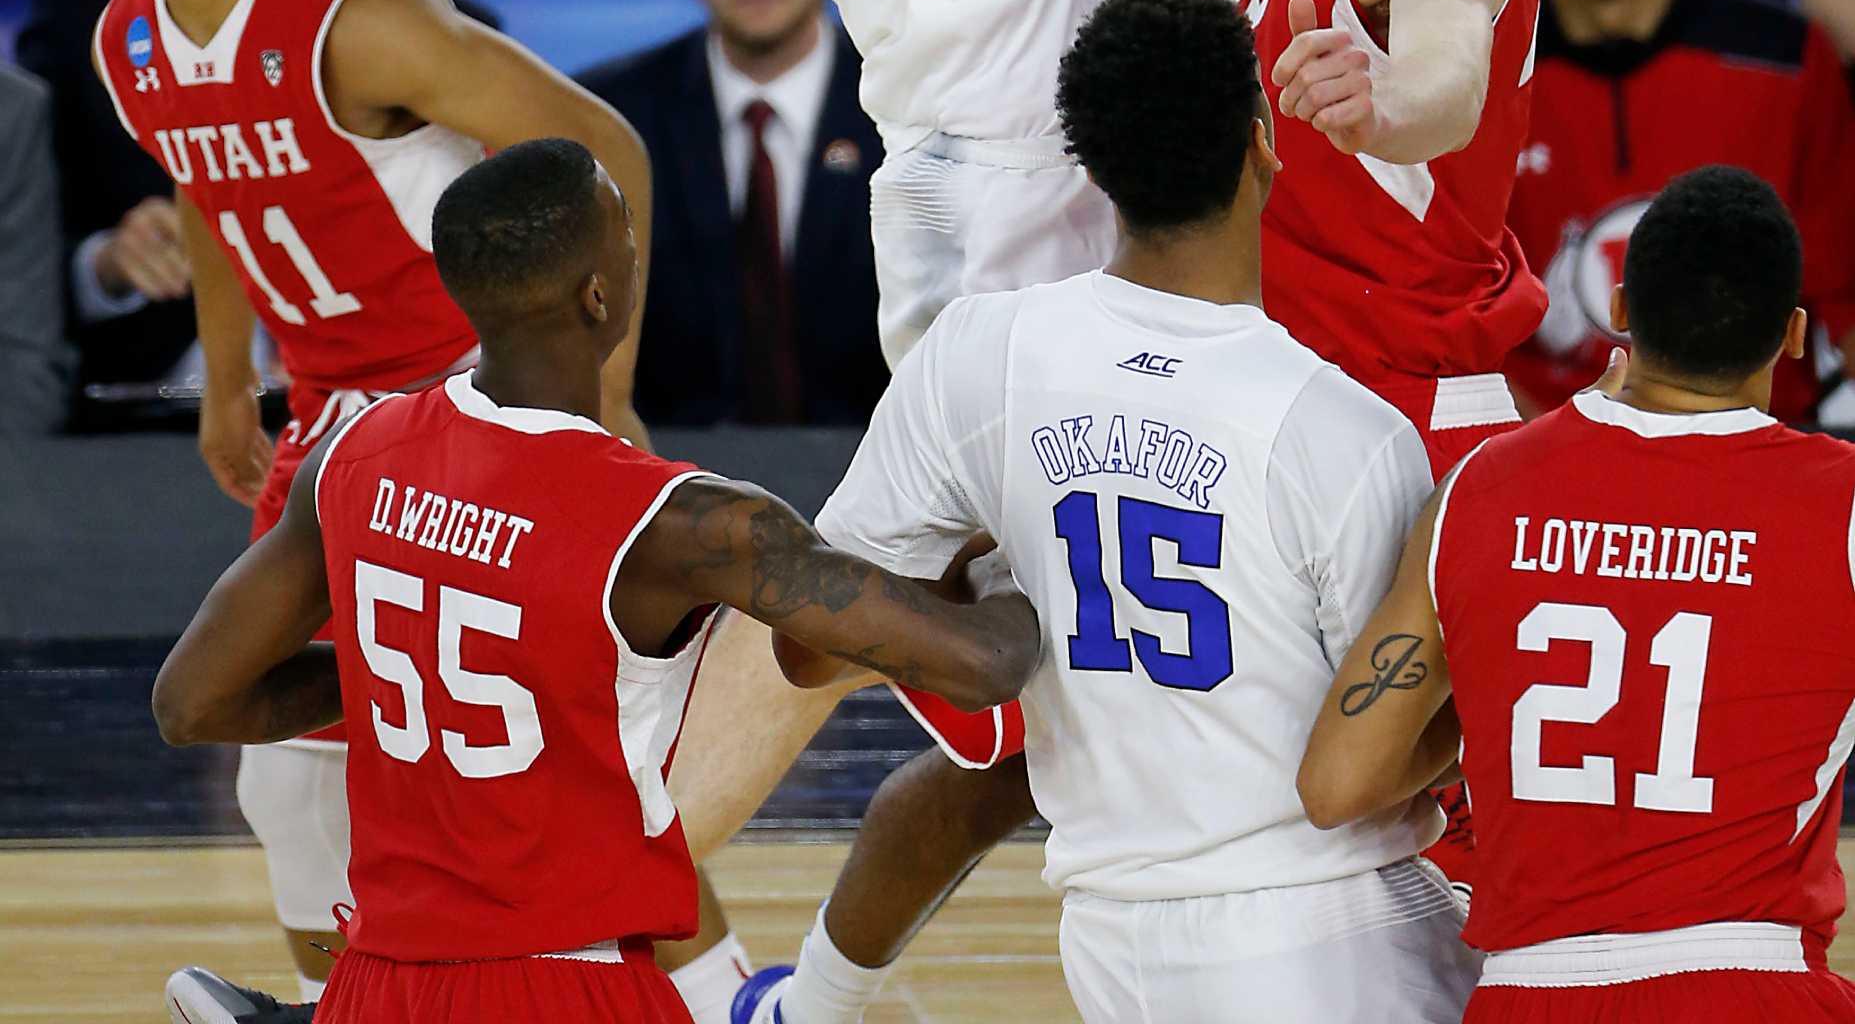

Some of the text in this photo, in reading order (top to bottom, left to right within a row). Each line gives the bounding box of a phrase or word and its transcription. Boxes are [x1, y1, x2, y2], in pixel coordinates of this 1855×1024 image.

[154, 117, 311, 185] UTAH
[218, 204, 363, 326] 11
[1117, 352, 1184, 376] ACC
[1032, 415, 1227, 509] OKAFOR
[369, 477, 535, 569] D.WRIGHT
[1511, 516, 1757, 586] LOVERIDGE
[1053, 490, 1234, 692] 15
[355, 559, 546, 778] 55
[1511, 602, 1714, 813] 21
